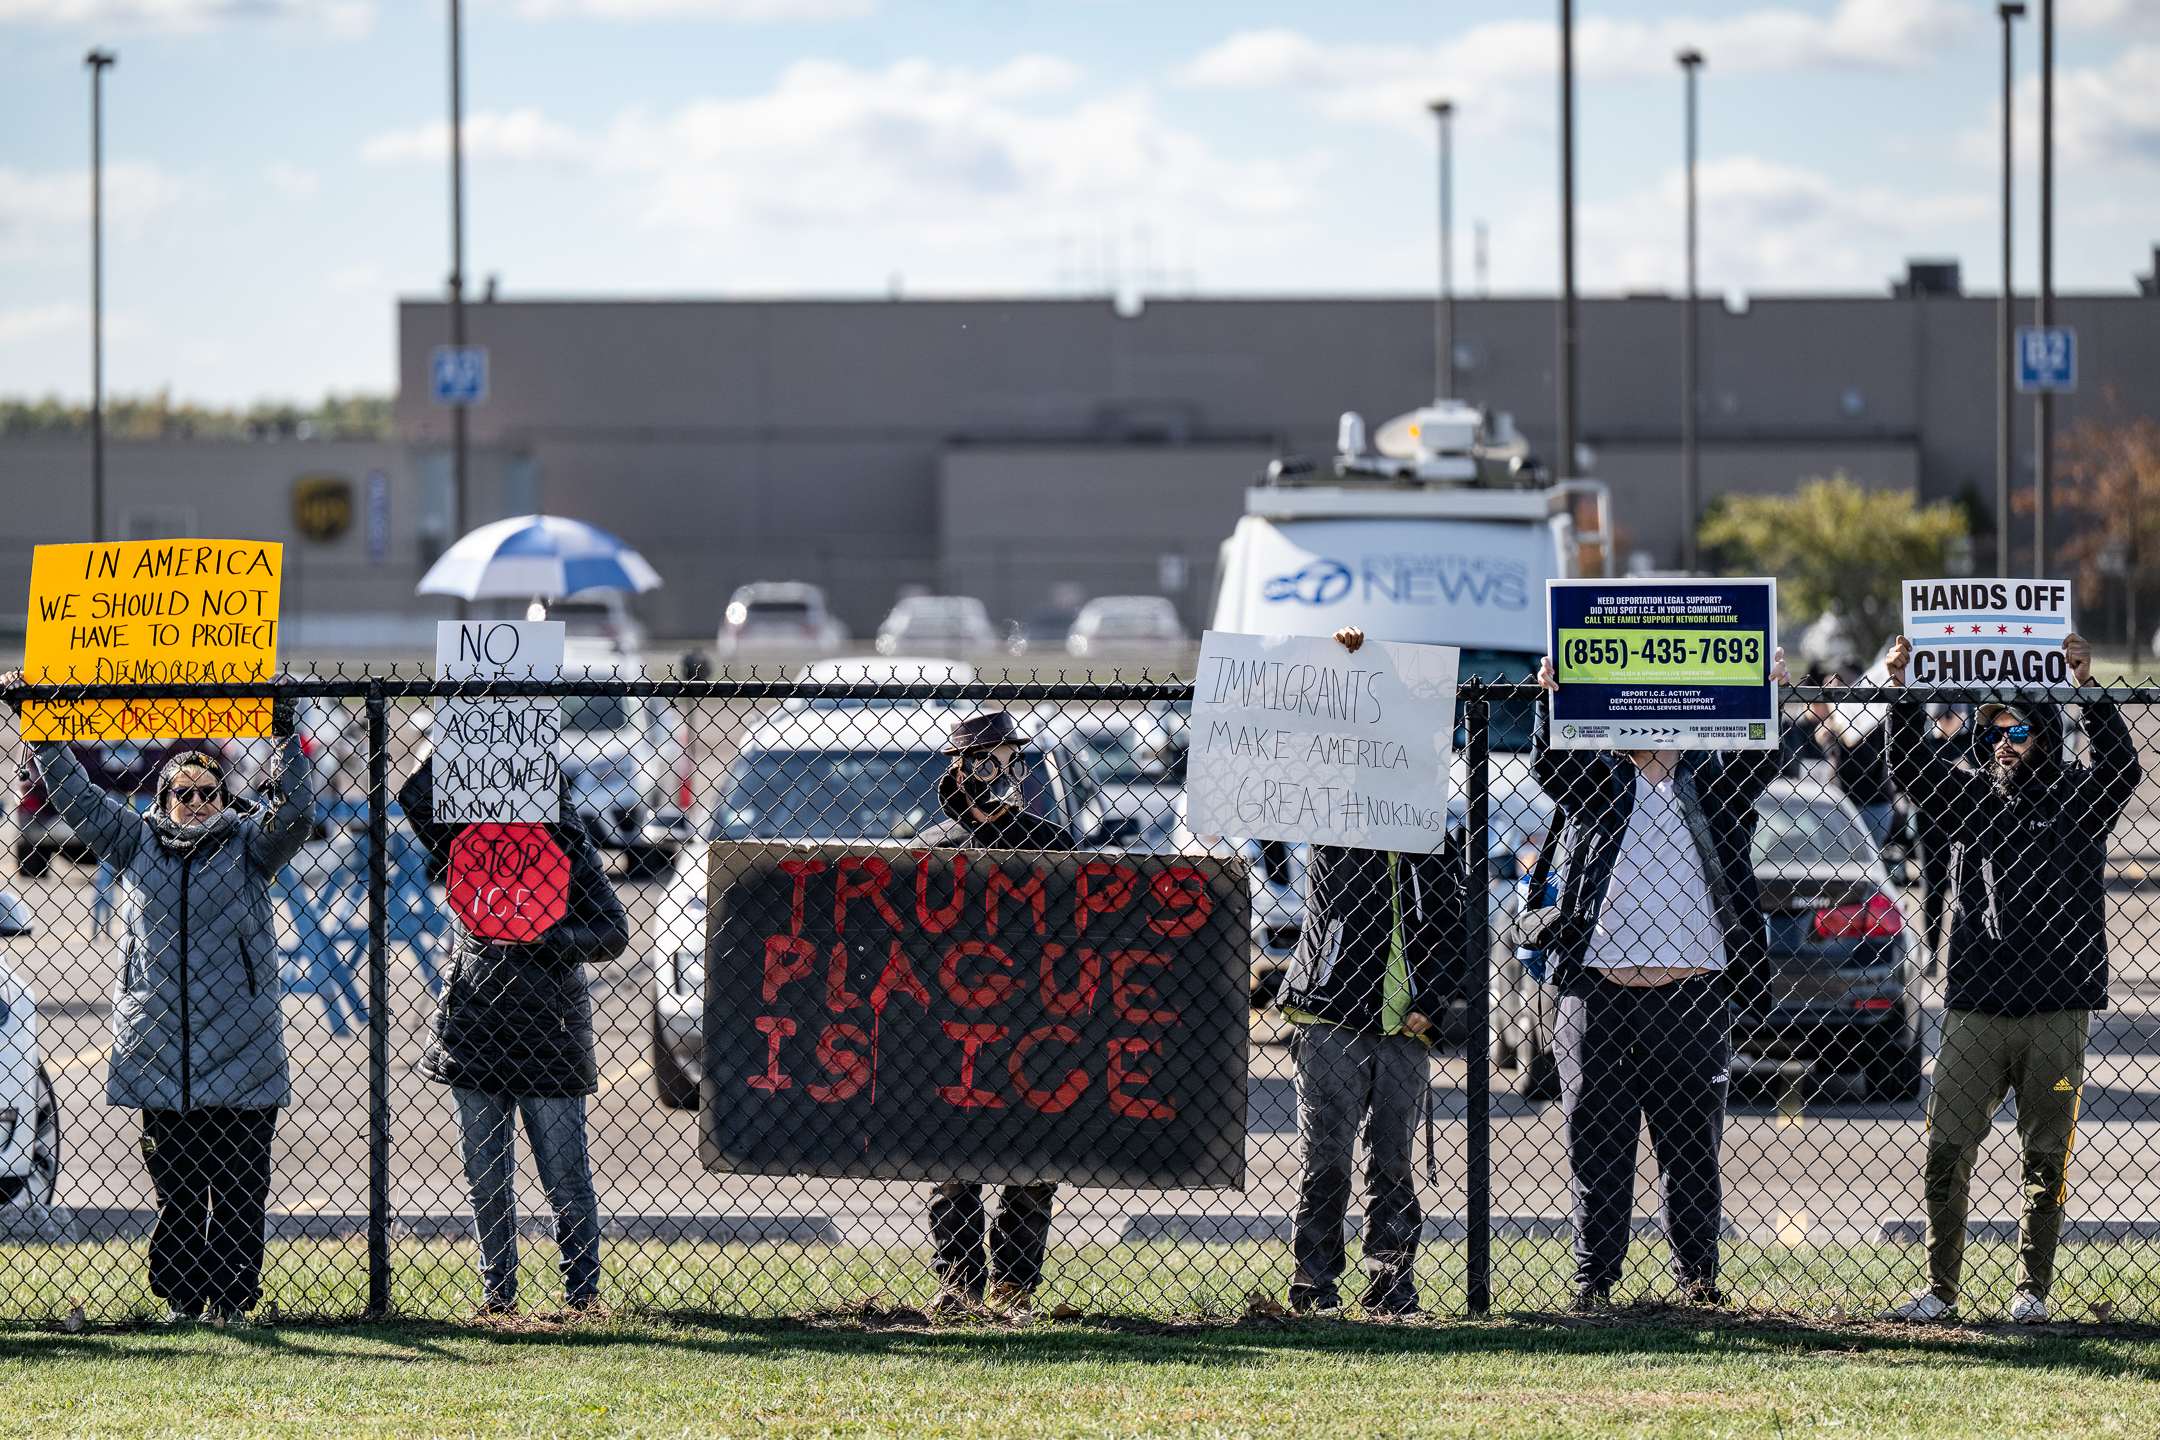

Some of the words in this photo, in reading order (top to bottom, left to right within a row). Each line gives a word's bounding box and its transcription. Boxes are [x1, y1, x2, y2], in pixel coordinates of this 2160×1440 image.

[85, 548, 120, 579] IN
[133, 546, 273, 578] AMERICA
[40, 594, 80, 622] WE
[91, 590, 189, 619] SHOULD
[202, 589, 268, 617] NOT
[1363, 568, 1530, 611] NEWS
[1597, 596, 1615, 605] NEED
[1616, 596, 1663, 605] DEPORTATION
[1664, 596, 1685, 604] LEGAL
[1686, 596, 1722, 604] SUPPORT?
[1911, 584, 2007, 612] HANDS
[2015, 584, 2065, 612] OFF
[1584, 616, 1601, 624] CALL
[1603, 616, 1616, 624] THE
[1617, 615, 1641, 624] FAMILY
[1642, 615, 1674, 624] SUPPORT
[1676, 615, 1709, 623] NETWORK
[1710, 615, 1738, 623] HOTLINE
[1590, 606, 1603, 615] DID
[1605, 606, 1618, 615] YOU
[1620, 606, 1637, 614] SPOT
[1639, 606, 1656, 614] I.C.E.
[1658, 606, 1665, 614] IN
[1667, 606, 1686, 614] YOUR
[1687, 605, 1732, 614] COMMUNITY?
[70, 624, 129, 650] HAVE
[148, 623, 179, 646] TO
[192, 620, 277, 649] PROTECT
[460, 623, 519, 665] NO
[96, 657, 263, 685] DEMOCRACY
[1564, 637, 1759, 670] (855)-435-7693
[1914, 649, 2066, 684] CHICAGO
[1205, 656, 1383, 724] IMMIGRANTS
[53, 713, 103, 735] THE
[121, 706, 269, 735] PRESIDENT
[441, 709, 558, 747] AGENTS
[1207, 720, 1291, 761] MAKE
[1307, 735, 1409, 769] AMERICA
[445, 751, 558, 791] ALLOWED
[438, 796, 456, 821] IN
[1236, 776, 1339, 828] GREAT
[1341, 789, 1440, 832] #NOKINGS
[464, 839, 541, 880] STOP
[472, 886, 537, 921] ICE
[780, 850, 1215, 938] TRUMPS
[762, 935, 1182, 1026] PLAGUE
[747, 1016, 873, 1103] IS
[936, 1020, 1176, 1120] ICE
